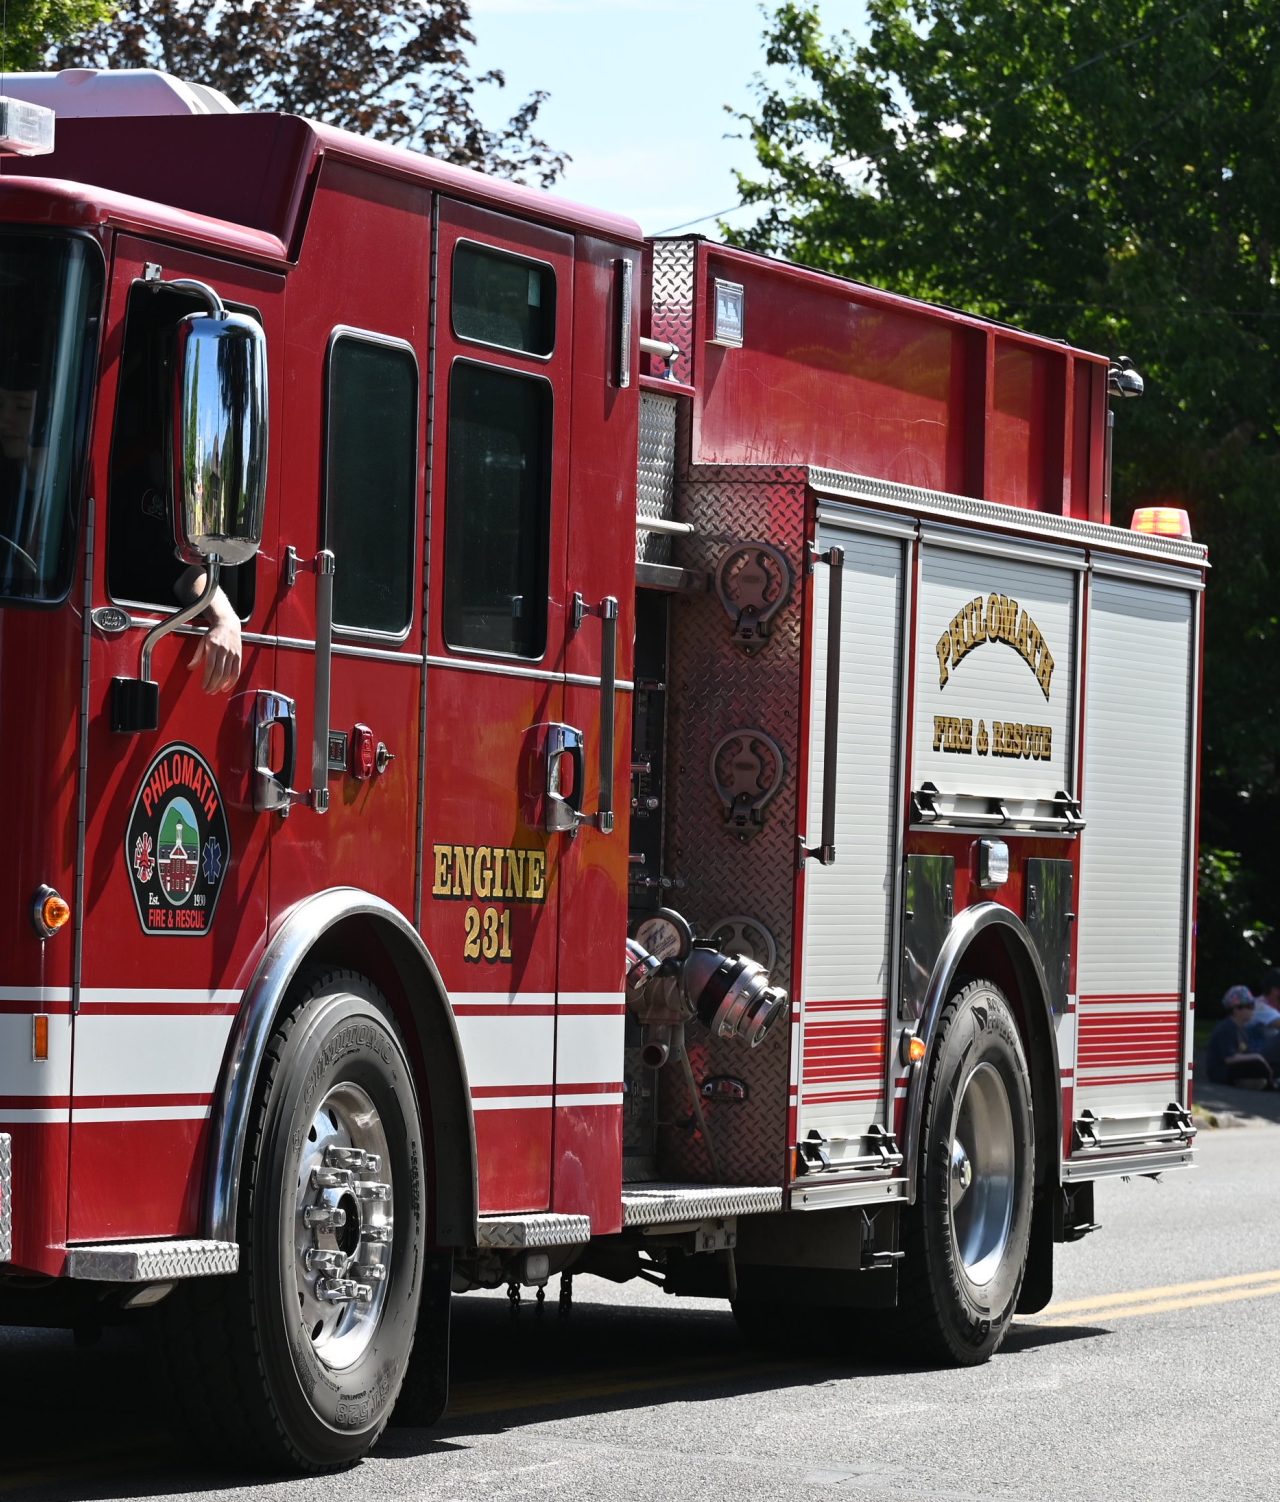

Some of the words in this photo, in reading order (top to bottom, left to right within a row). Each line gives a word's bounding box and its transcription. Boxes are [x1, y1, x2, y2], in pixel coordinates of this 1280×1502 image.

[935, 592, 1055, 702] PHILOMATH
[933, 715, 973, 754] FIRE
[976, 719, 989, 756] &
[992, 721, 1053, 761] RESCUE
[142, 753, 218, 822] PHILOMATH
[432, 844, 546, 904] ENGINE
[148, 908, 167, 927] FIRE
[167, 909, 174, 928] &
[175, 909, 206, 929] RESCUE
[463, 905, 513, 964] 231
